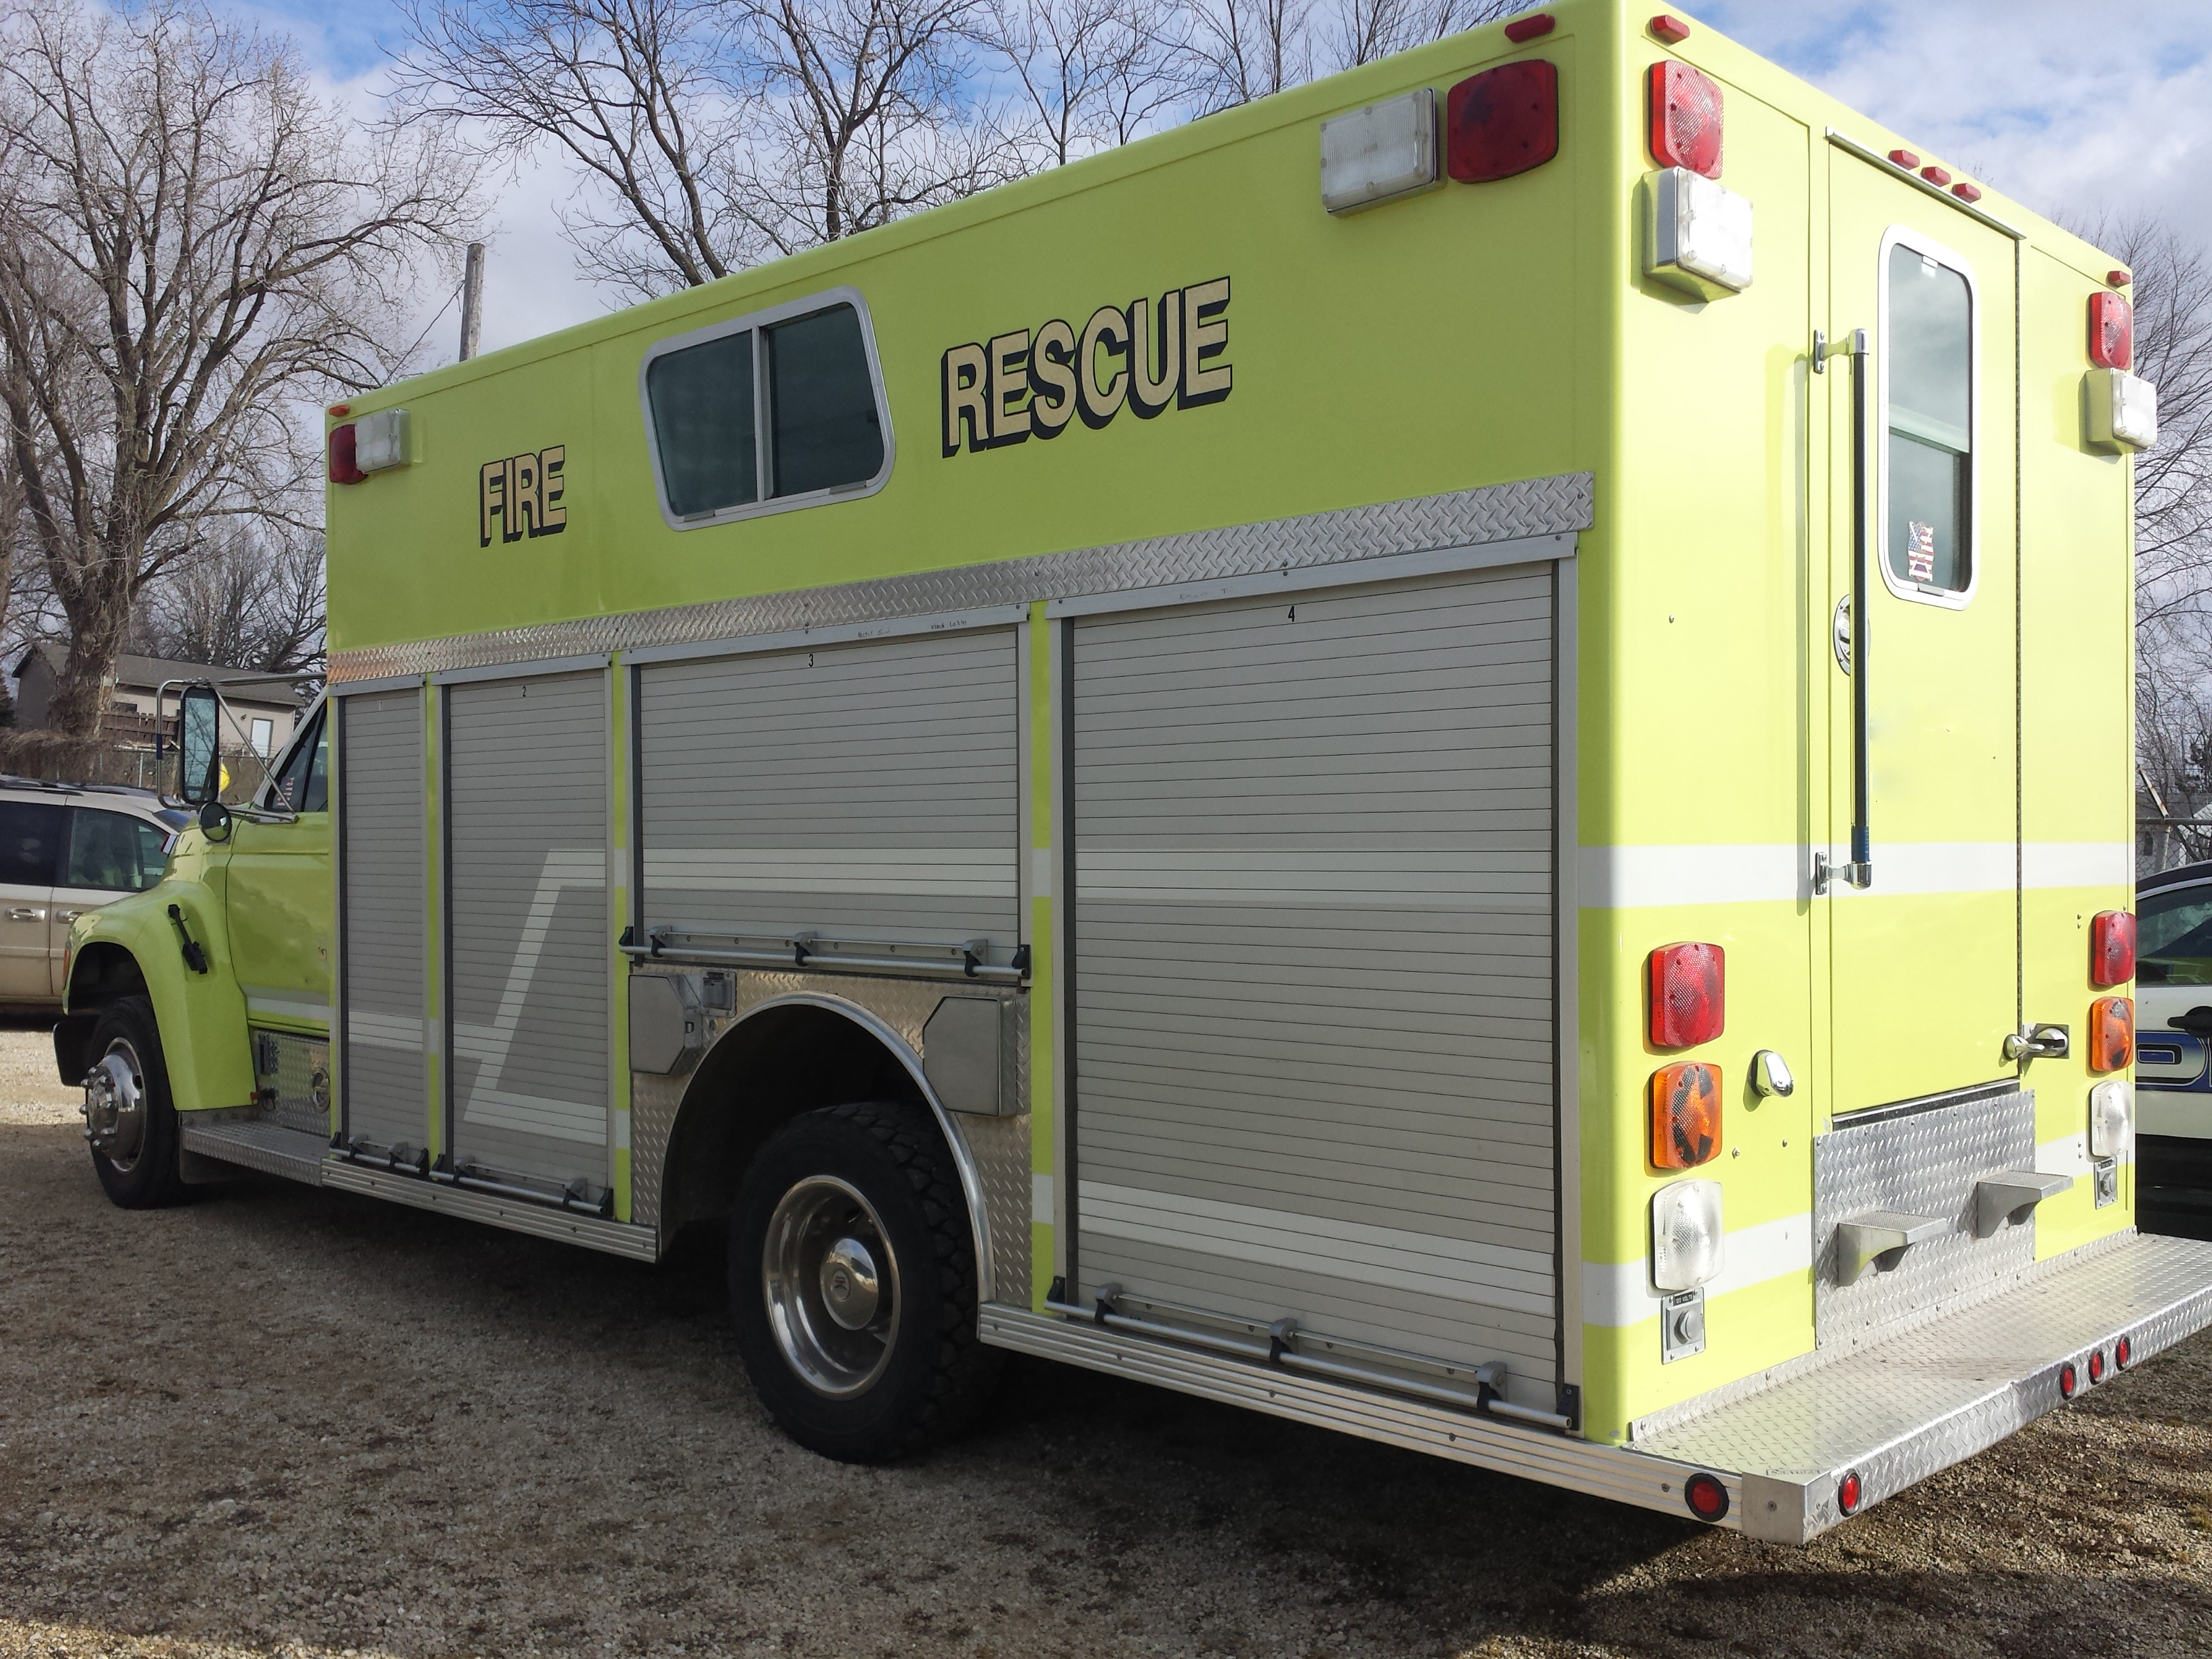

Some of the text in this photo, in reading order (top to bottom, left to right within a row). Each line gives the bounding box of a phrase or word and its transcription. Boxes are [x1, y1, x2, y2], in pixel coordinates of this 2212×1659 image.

[942, 276, 1233, 458] RESCUE
[480, 445, 567, 548] FIRE
[1288, 605, 1295, 622] 4
[808, 653, 814, 668] 3
[522, 686, 527, 697] 2
[1682, 1294, 1693, 1303] VOLTS
